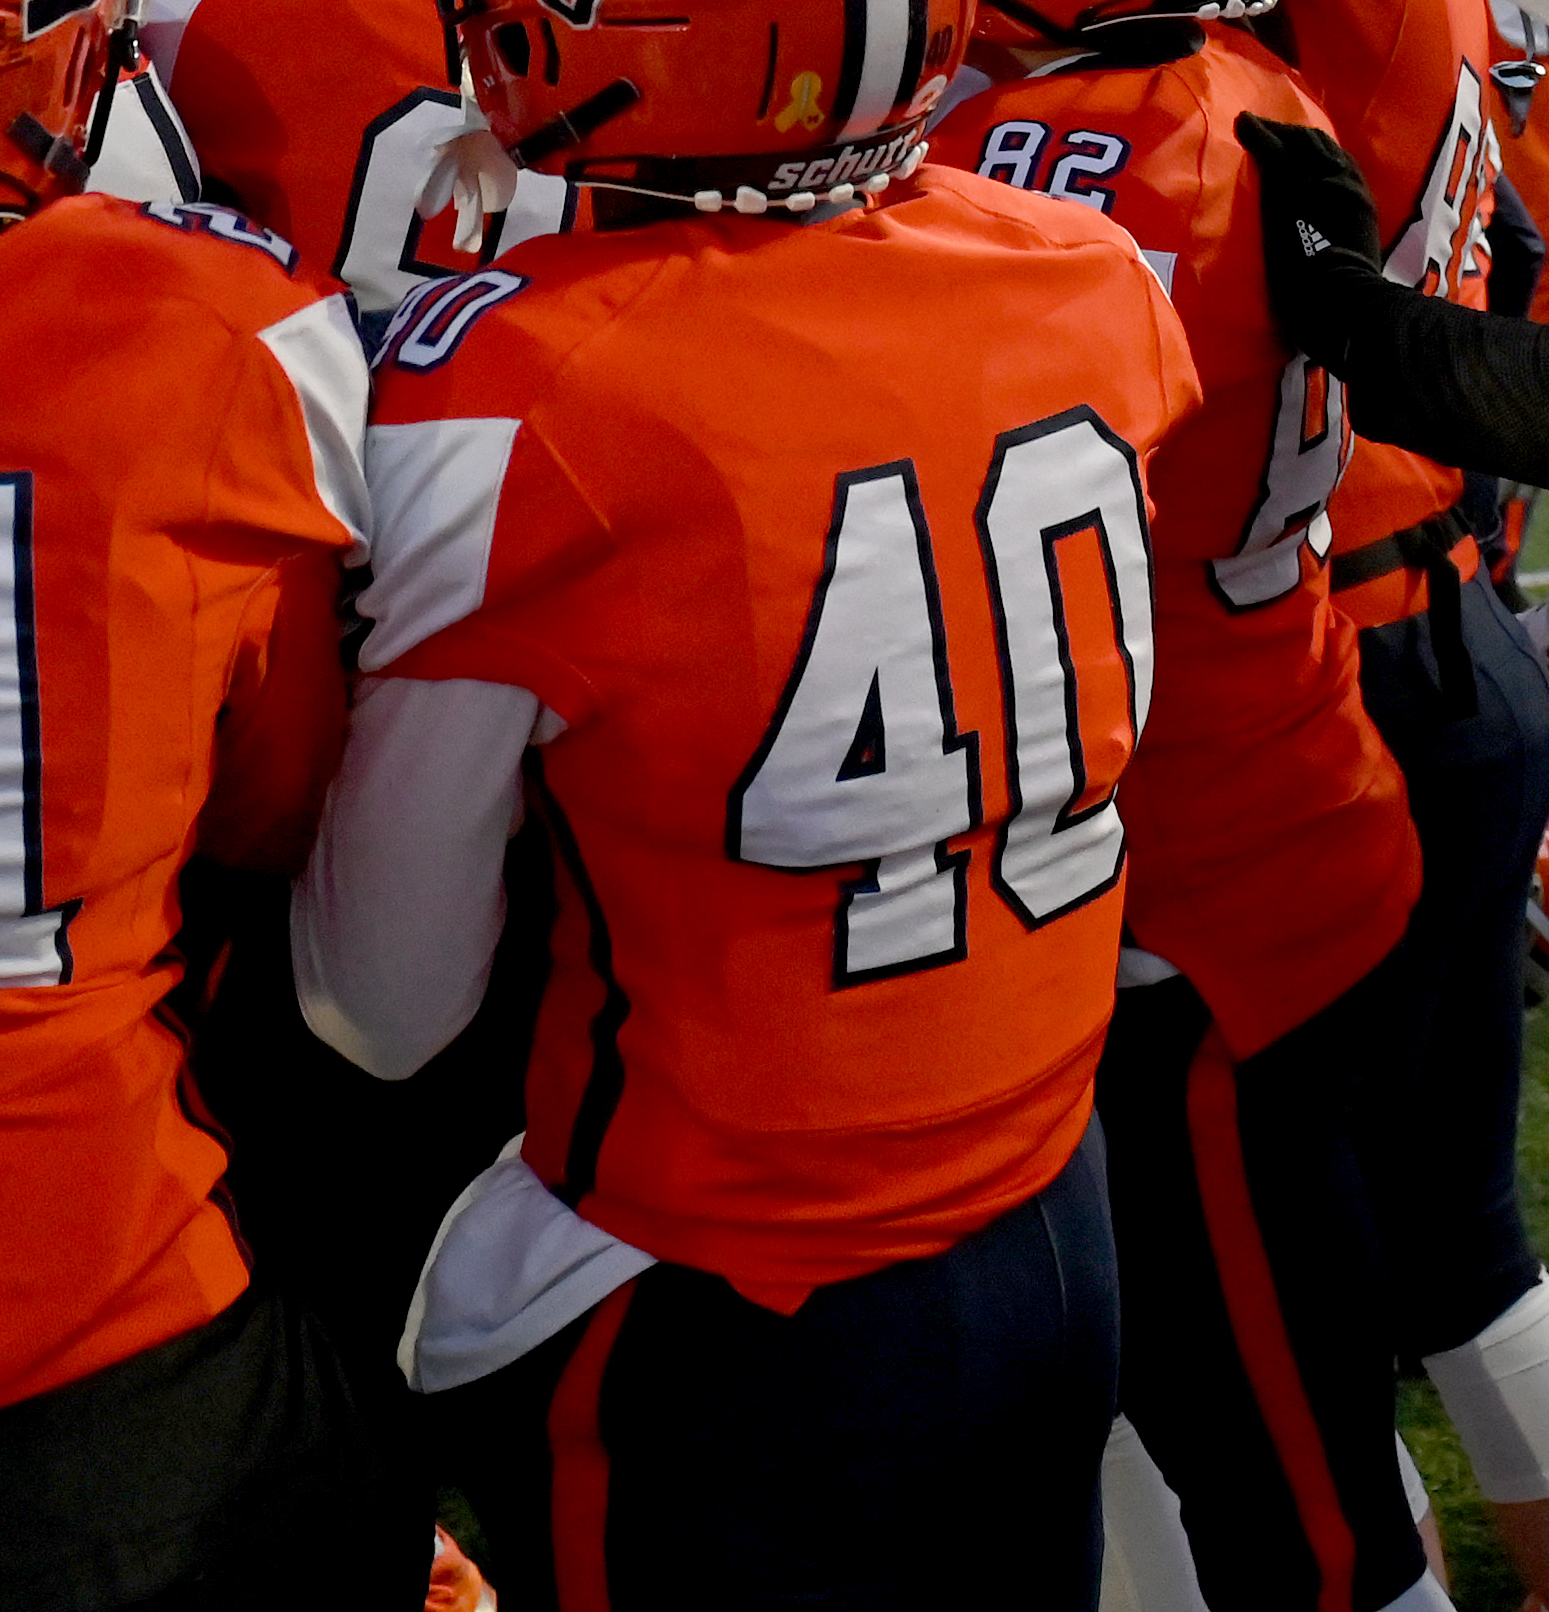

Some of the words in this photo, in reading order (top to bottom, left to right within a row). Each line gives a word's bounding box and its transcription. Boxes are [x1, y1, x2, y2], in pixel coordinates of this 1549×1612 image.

[767, 128, 917, 190] schutt
[977, 119, 1131, 214] 82
[727, 405, 1156, 990] 40
